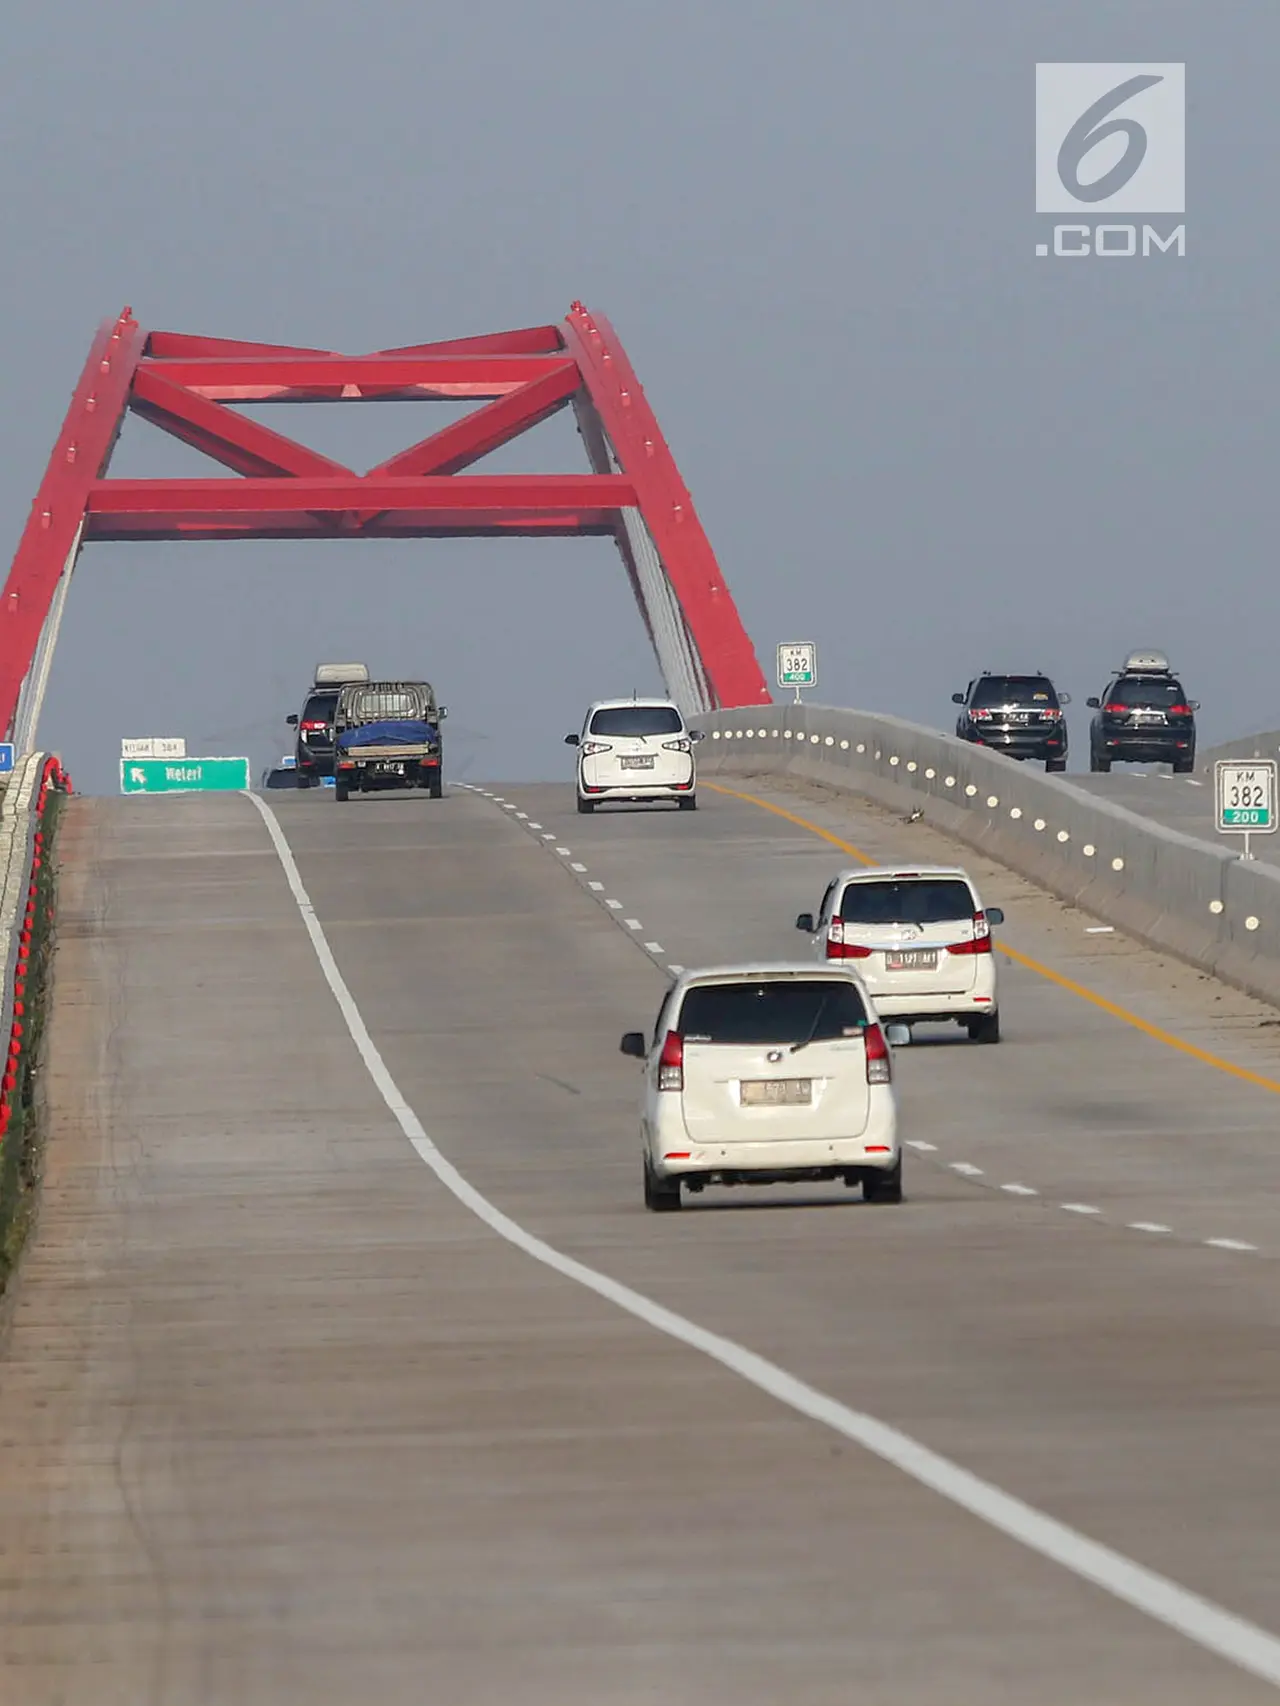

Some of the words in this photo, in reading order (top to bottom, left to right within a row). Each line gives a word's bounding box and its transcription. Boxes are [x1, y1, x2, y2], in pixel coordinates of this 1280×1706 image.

[786, 658, 808, 671] 382
[1236, 772, 1256, 783] KM
[1230, 785, 1264, 807] 382
[1231, 811, 1259, 823] 200
